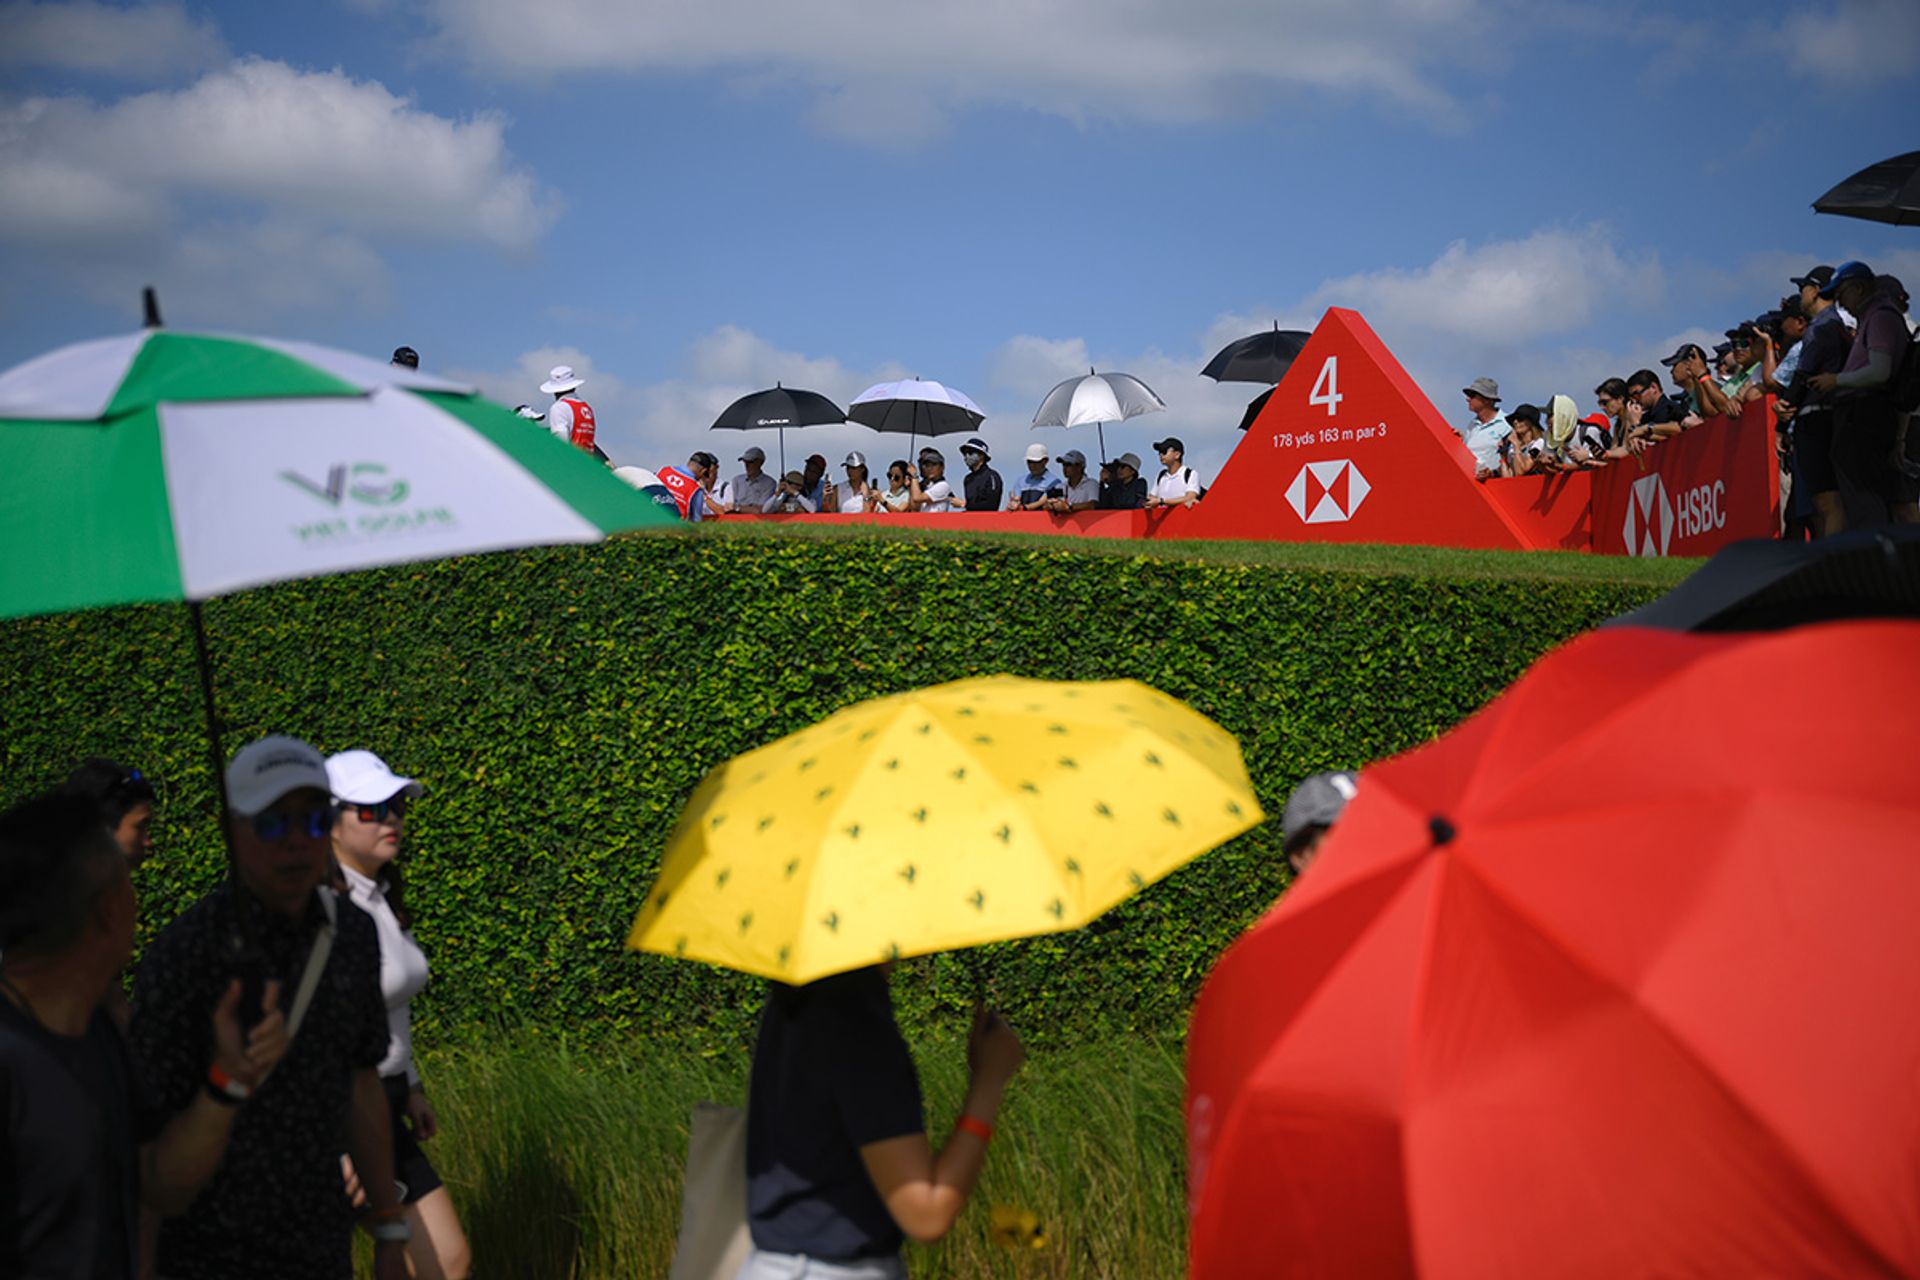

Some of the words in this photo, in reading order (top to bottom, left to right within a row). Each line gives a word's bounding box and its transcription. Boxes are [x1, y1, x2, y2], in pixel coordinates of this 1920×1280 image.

[1309, 355, 1343, 416] 4
[1273, 433, 1293, 448] 178
[1295, 431, 1315, 449] yds
[1319, 427, 1339, 443] 163
[1342, 429, 1353, 440] m
[1356, 427, 1375, 442] par
[1378, 422, 1387, 437] 3
[1677, 479, 1726, 539] HSBC
